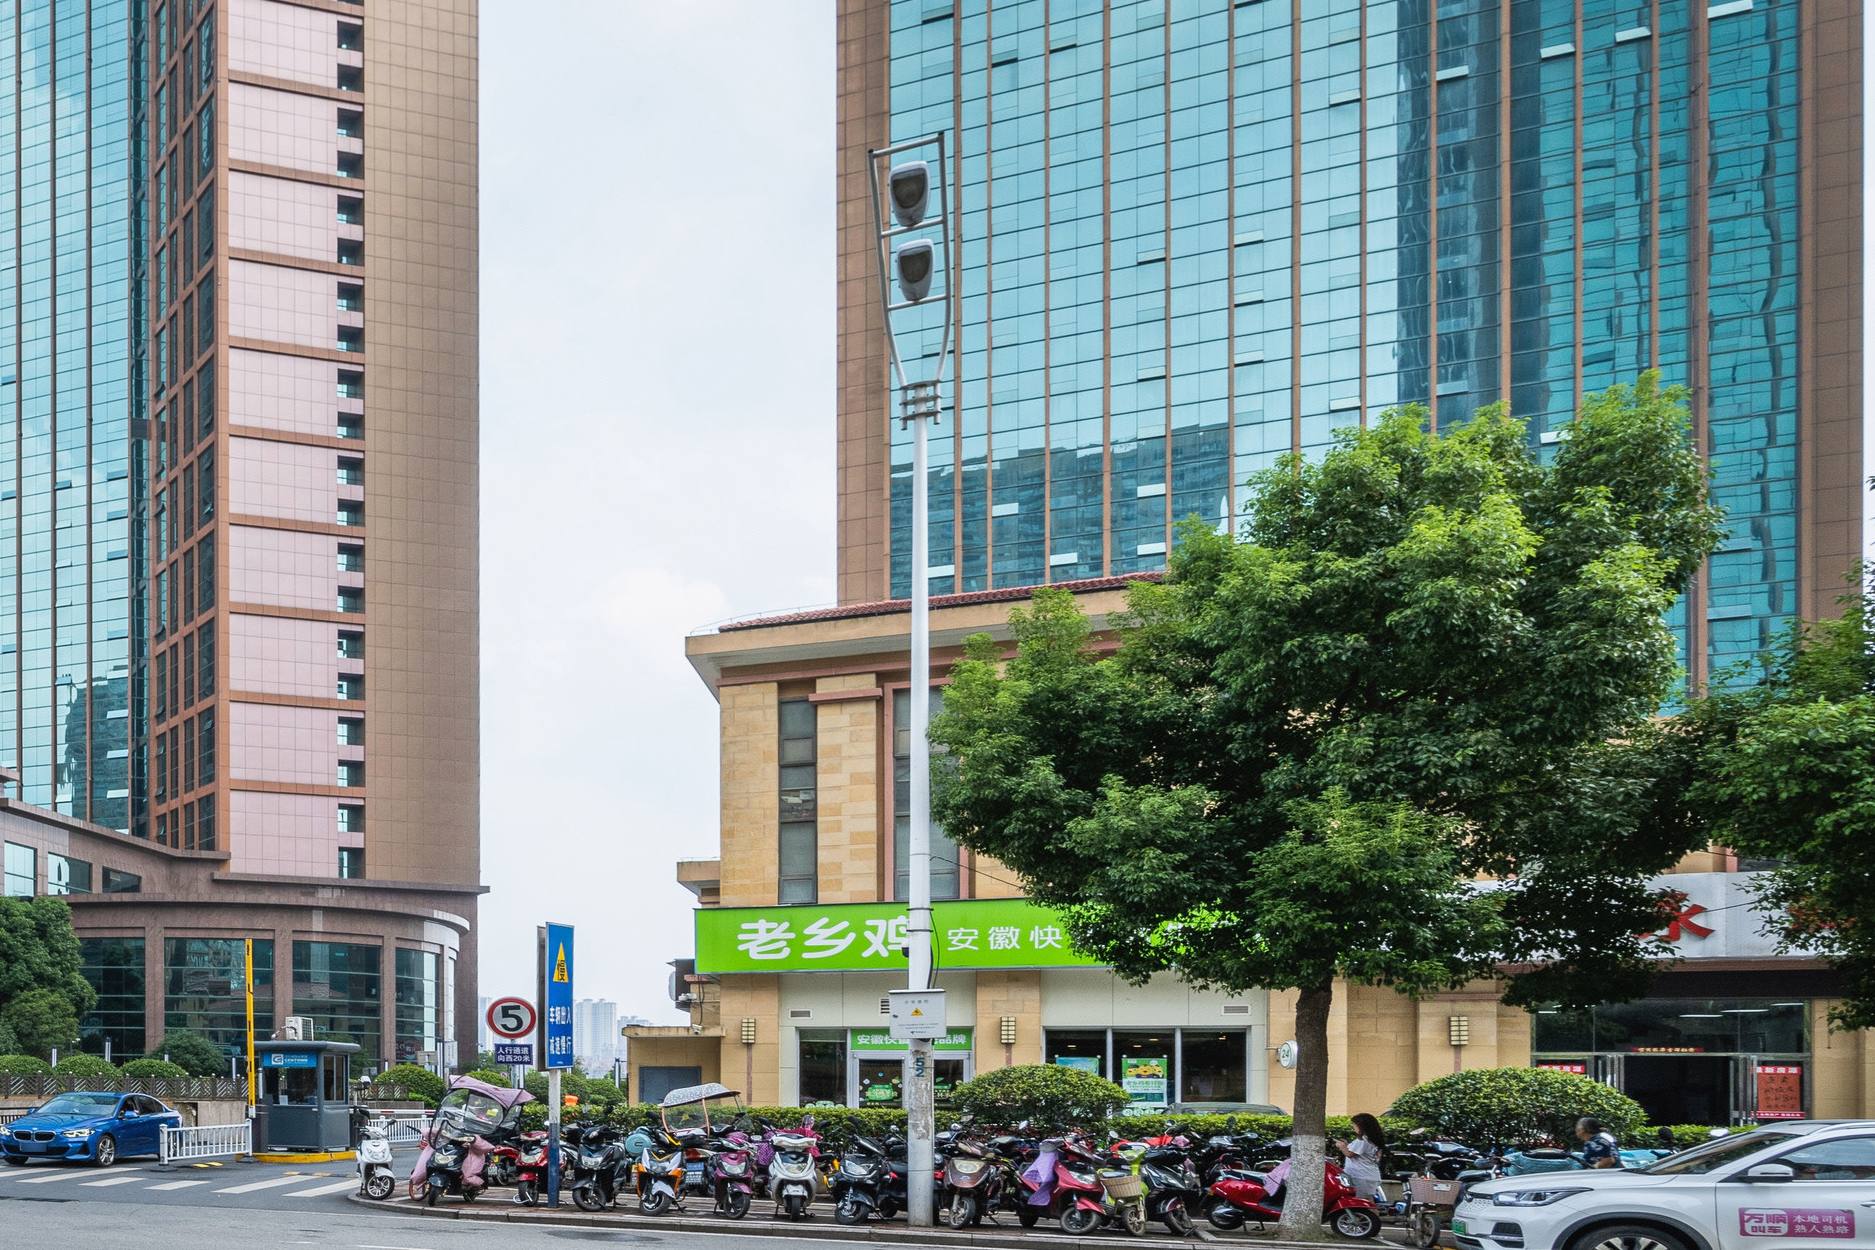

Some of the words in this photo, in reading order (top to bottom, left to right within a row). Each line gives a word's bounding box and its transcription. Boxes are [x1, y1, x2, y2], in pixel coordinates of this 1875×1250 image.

[736, 915, 910, 960] 老乡鸡
[500, 1005, 524, 1032] 5
[549, 1005, 572, 1025] 车辆出入
[497, 1046, 529, 1055] 人行通道
[497, 1054, 531, 1063] 向西20米
[1744, 1213, 1787, 1224] 万顺
[1793, 1214, 1848, 1224] 本地司机
[1750, 1225, 1782, 1233] 叫车
[1794, 1225, 1850, 1234] 熟人熟路
